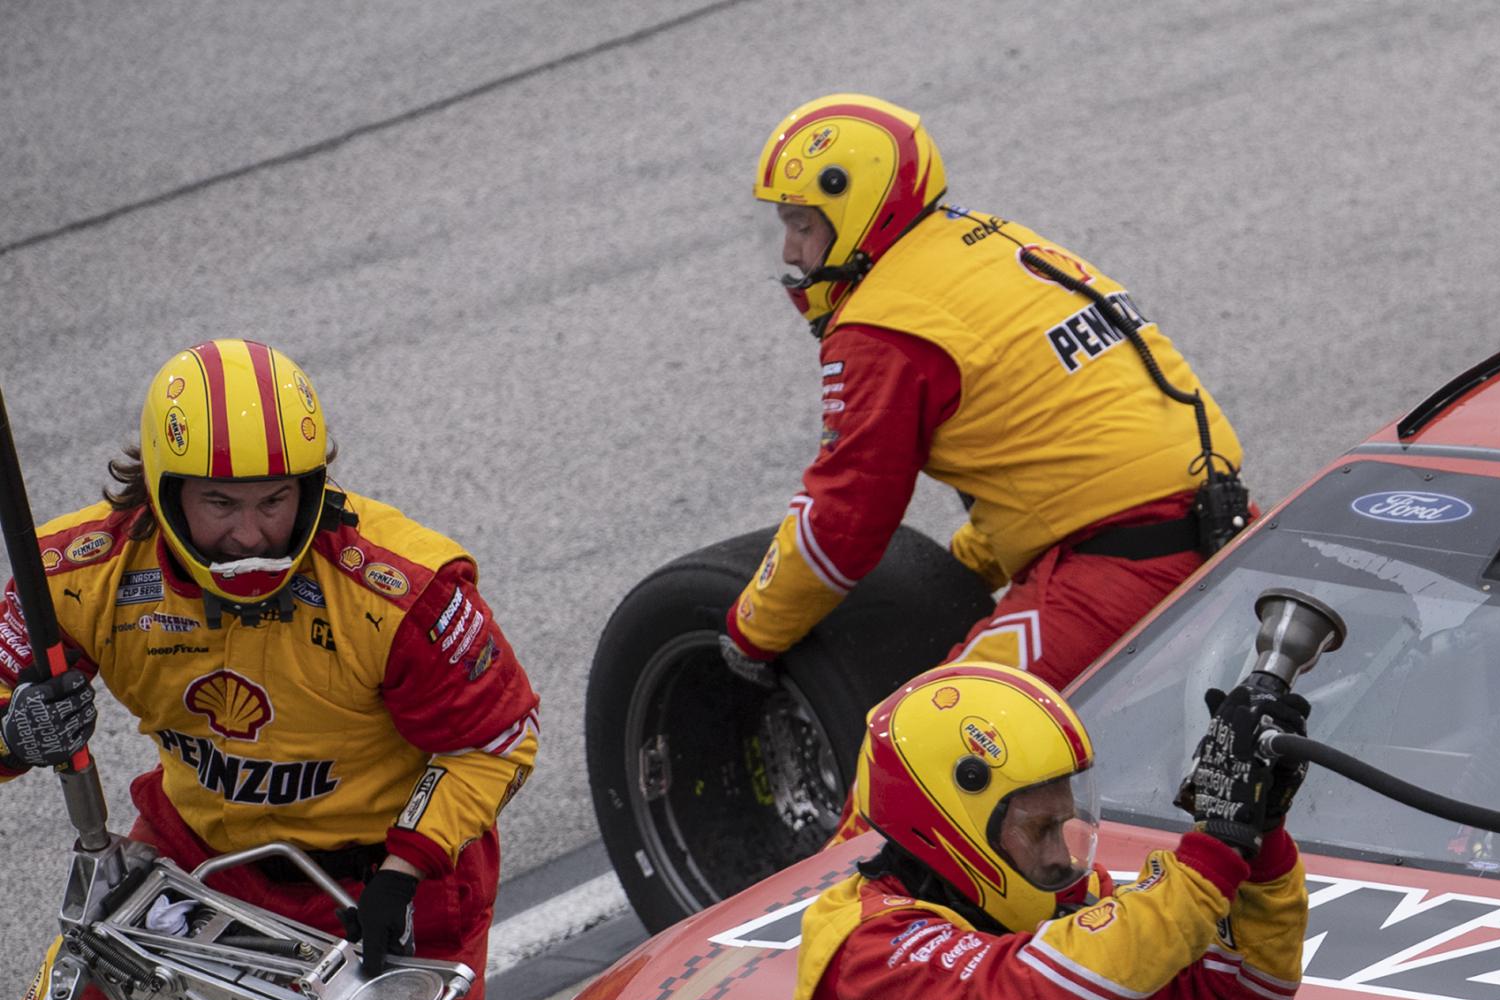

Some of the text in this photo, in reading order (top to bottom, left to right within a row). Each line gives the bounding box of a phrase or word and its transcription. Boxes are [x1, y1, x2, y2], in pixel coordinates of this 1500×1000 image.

[1371, 493, 1446, 522] Ford
[291, 578, 323, 603] Ford
[26, 695, 63, 754] Mechanix
[964, 722, 1003, 760] PENNZOIL
